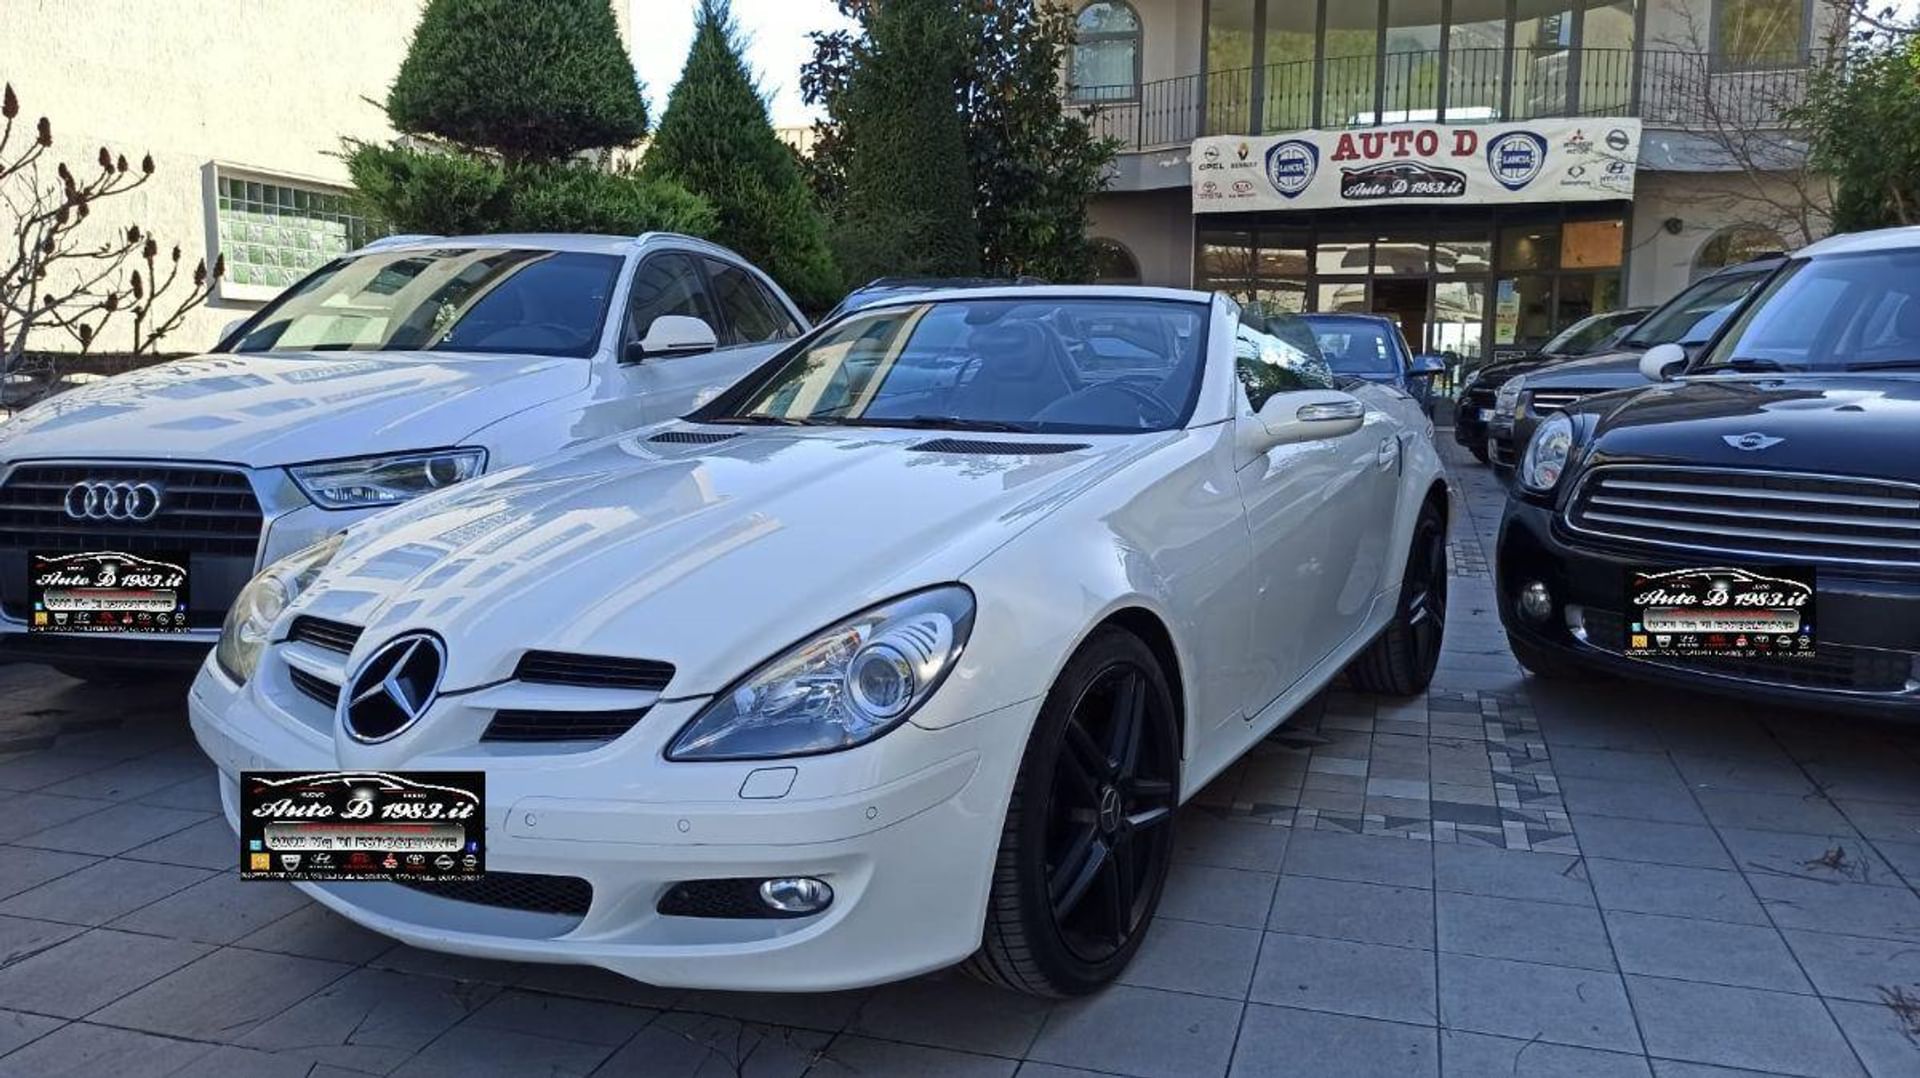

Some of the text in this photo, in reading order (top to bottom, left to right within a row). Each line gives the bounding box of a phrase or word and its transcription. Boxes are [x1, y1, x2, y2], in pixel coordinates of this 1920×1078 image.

[1330, 129, 1478, 161] AUTO D
[1199, 162, 1224, 171] OPEL
[1343, 178, 1463, 197] Auto D 1983.it
